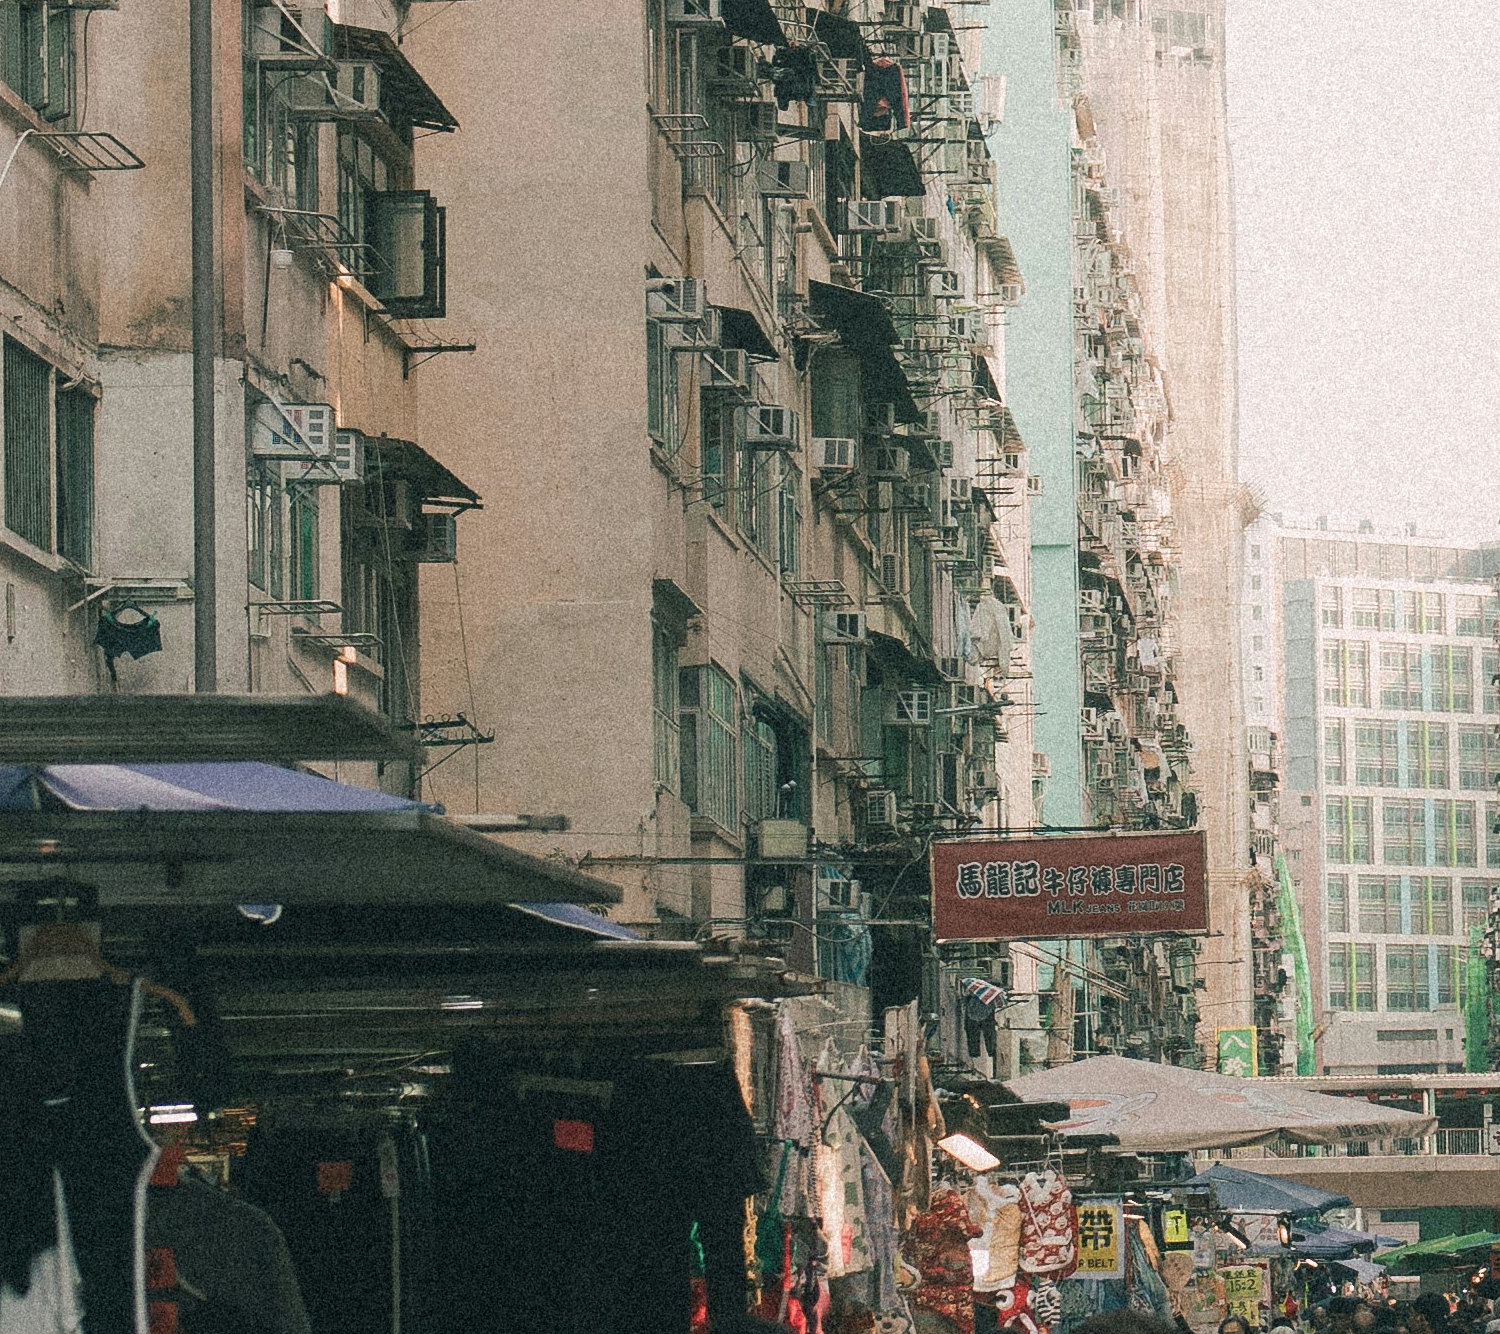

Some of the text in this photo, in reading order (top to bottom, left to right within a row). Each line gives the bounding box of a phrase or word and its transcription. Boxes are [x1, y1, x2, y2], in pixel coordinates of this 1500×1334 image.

[1047, 900, 1084, 916] MLK
[1085, 903, 1121, 914] JEANS
[1087, 1258, 1114, 1268] BELT
